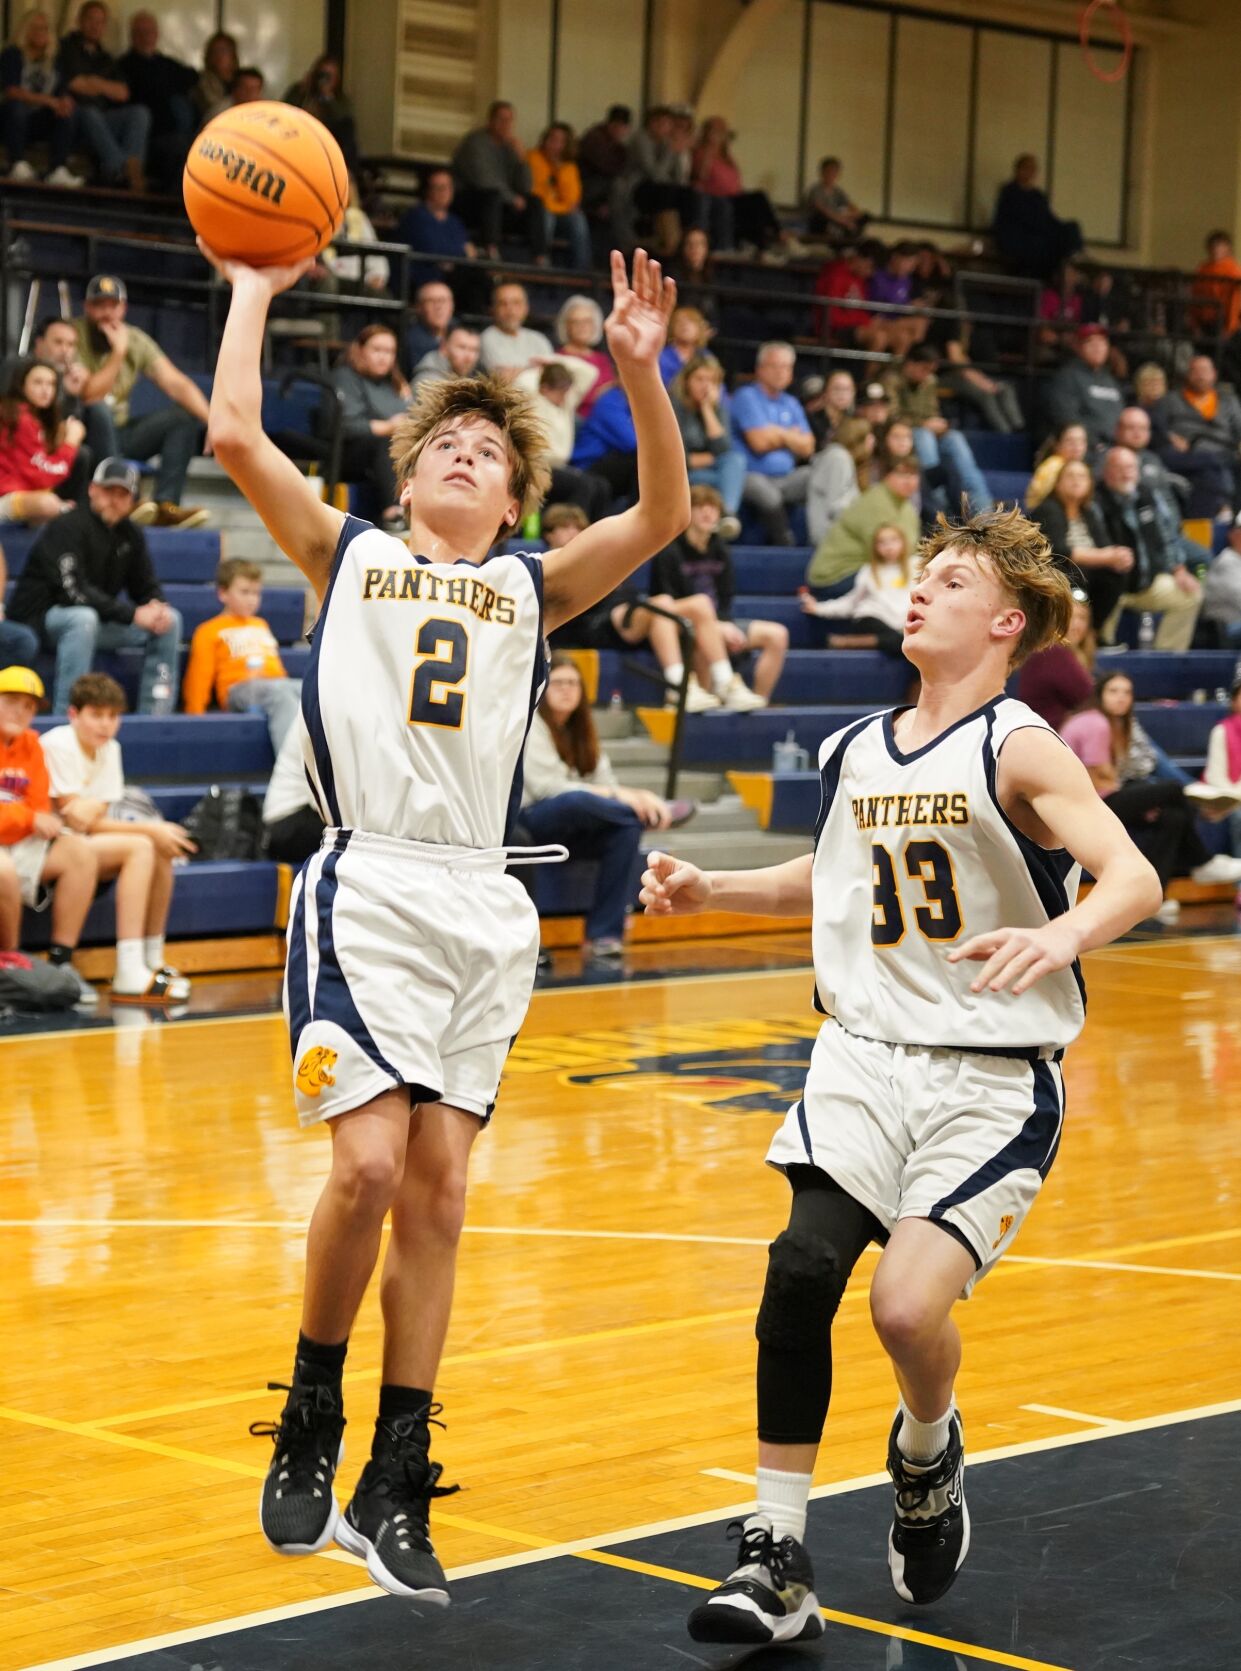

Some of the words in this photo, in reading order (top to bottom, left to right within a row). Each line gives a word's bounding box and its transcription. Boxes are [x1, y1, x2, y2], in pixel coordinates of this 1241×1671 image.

[199, 138, 286, 207] Wilson
[362, 567, 516, 627] PANTHERS
[408, 616, 469, 732] 2
[850, 792, 971, 831] PANTHERS
